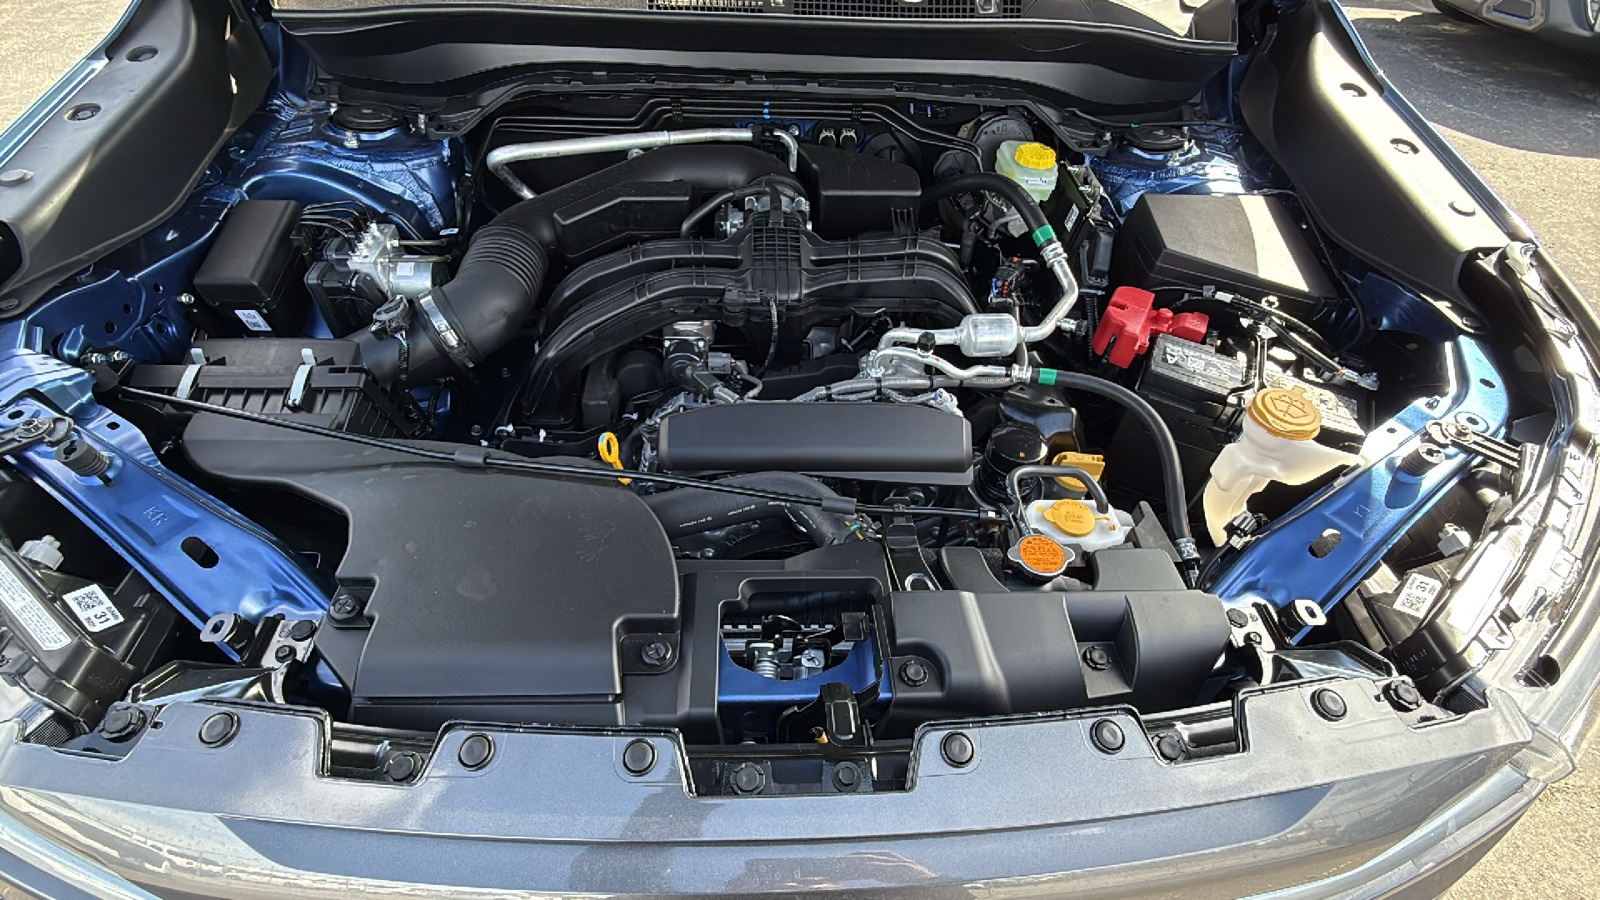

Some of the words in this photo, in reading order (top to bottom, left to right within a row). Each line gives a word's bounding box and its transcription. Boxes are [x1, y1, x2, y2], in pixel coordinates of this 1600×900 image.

[142, 506, 169, 526] KR
[1415, 581, 1430, 592] 31
[94, 611, 111, 624] 31
